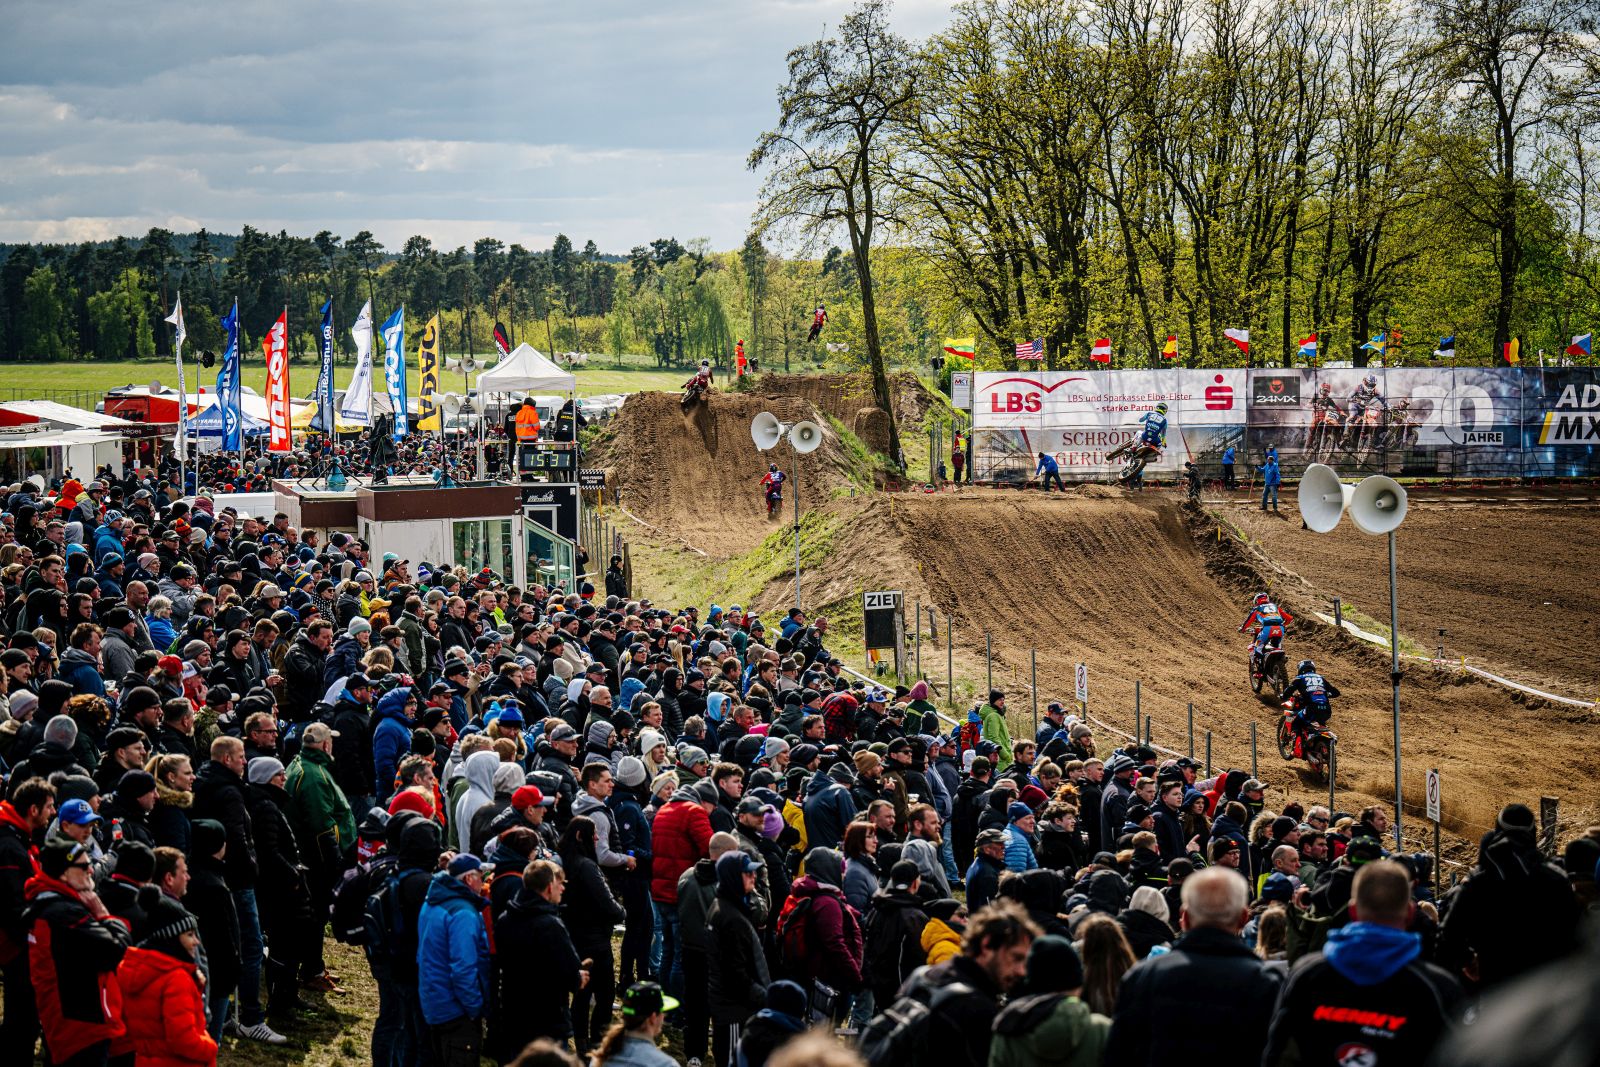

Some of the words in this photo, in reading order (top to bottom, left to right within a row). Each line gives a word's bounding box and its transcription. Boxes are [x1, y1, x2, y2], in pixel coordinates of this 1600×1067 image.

[270, 322, 287, 445] MOTUL
[992, 392, 1042, 413] LBS
[1067, 394, 1084, 403] LBS
[1085, 394, 1102, 402] und
[1103, 393, 1145, 404] Sparkasse
[1147, 393, 1193, 401] Elbe-Elster
[1256, 395, 1297, 403] 24MX
[1102, 403, 1129, 412] starke
[1130, 403, 1156, 412] Partn
[1412, 384, 1494, 446] 20
[119, 427, 142, 435] Crêpes
[1062, 428, 1136, 446] SCHRÖD
[1462, 432, 1502, 444] JAHRE
[530, 453, 570, 467] 15:31
[1313, 1005, 1406, 1029] KENNY
